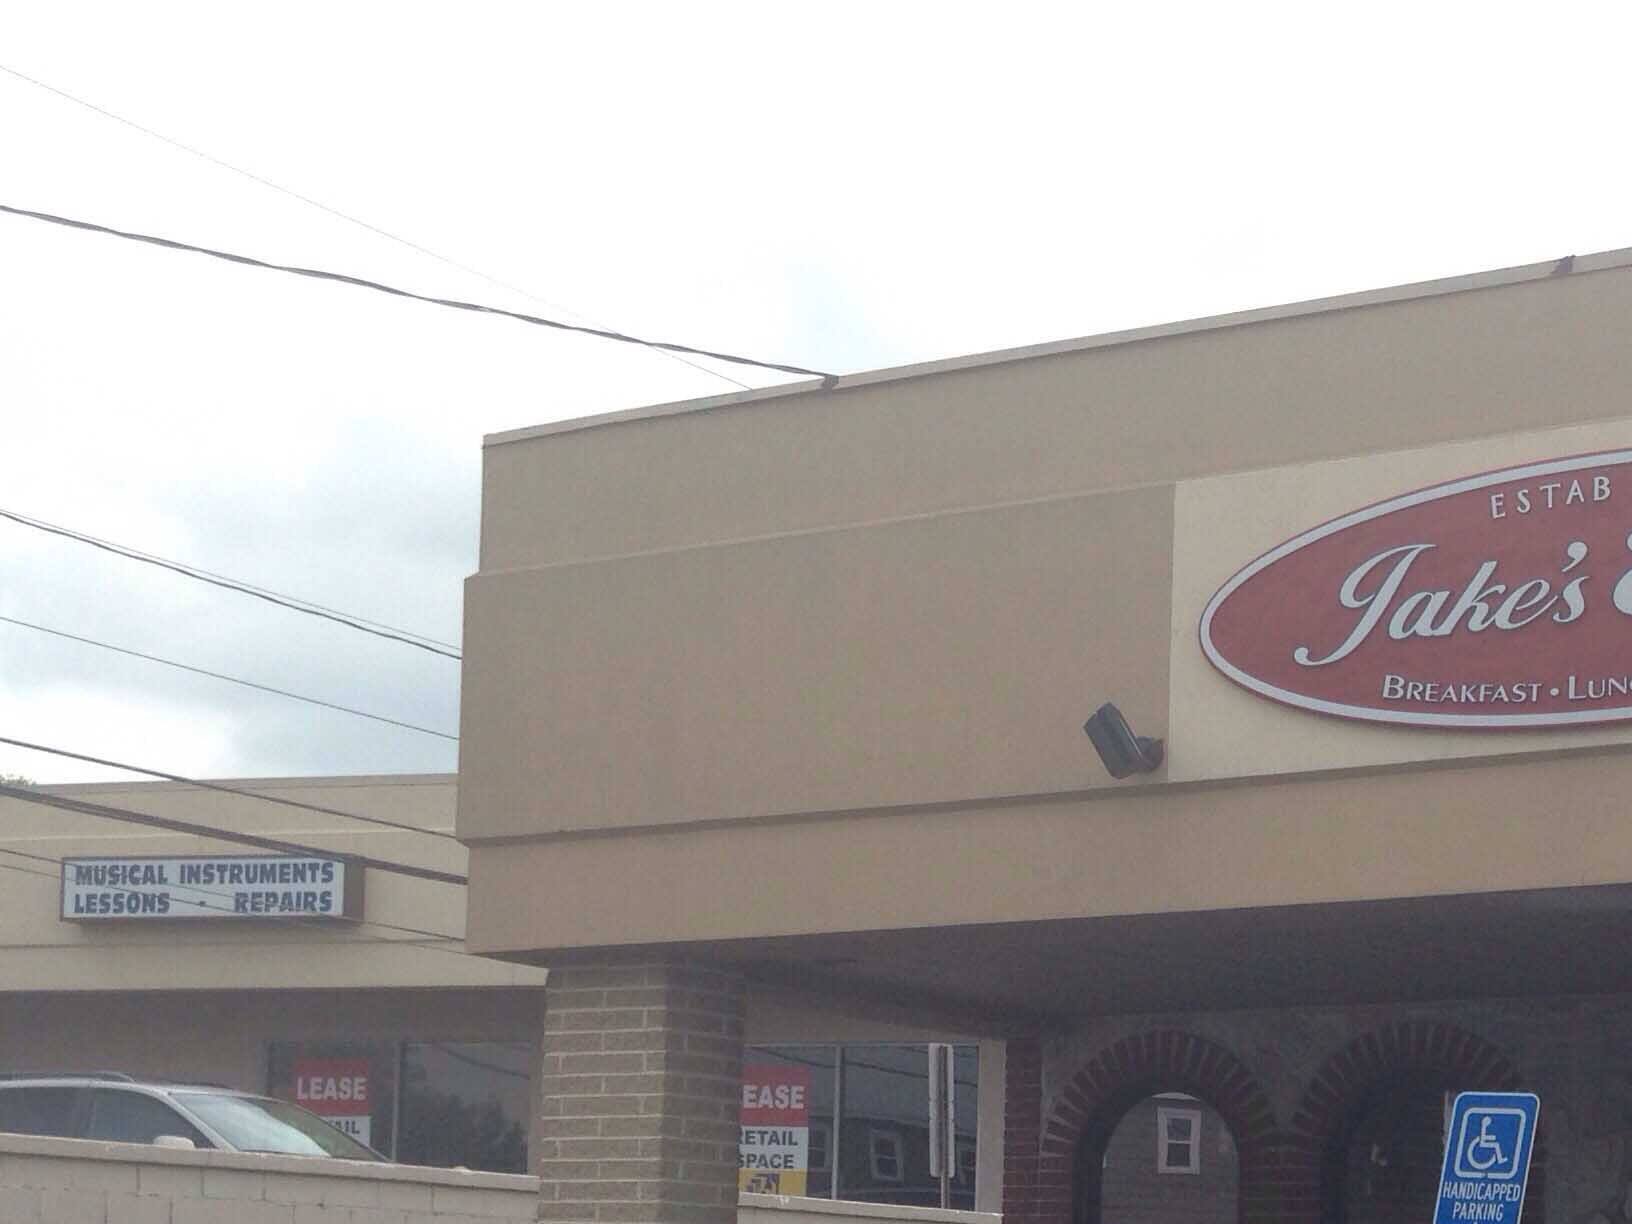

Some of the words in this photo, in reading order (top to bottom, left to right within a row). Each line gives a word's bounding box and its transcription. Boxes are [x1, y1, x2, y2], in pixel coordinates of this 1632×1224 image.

[1490, 476, 1612, 519] ESTAB
[1293, 541, 1591, 667] Jake's
[1381, 674, 1542, 703] BREAKFAST
[75, 863, 169, 886] MUSICAL
[179, 862, 334, 885] INSTRUMENTS
[74, 892, 170, 914] LESSONS
[233, 890, 333, 913] REPAIRS
[296, 1077, 368, 1101] LEASE
[742, 1084, 806, 1110] EASE
[1442, 1181, 1521, 1203] HANDICAPPED
[1452, 1201, 1505, 1222] PARKING
